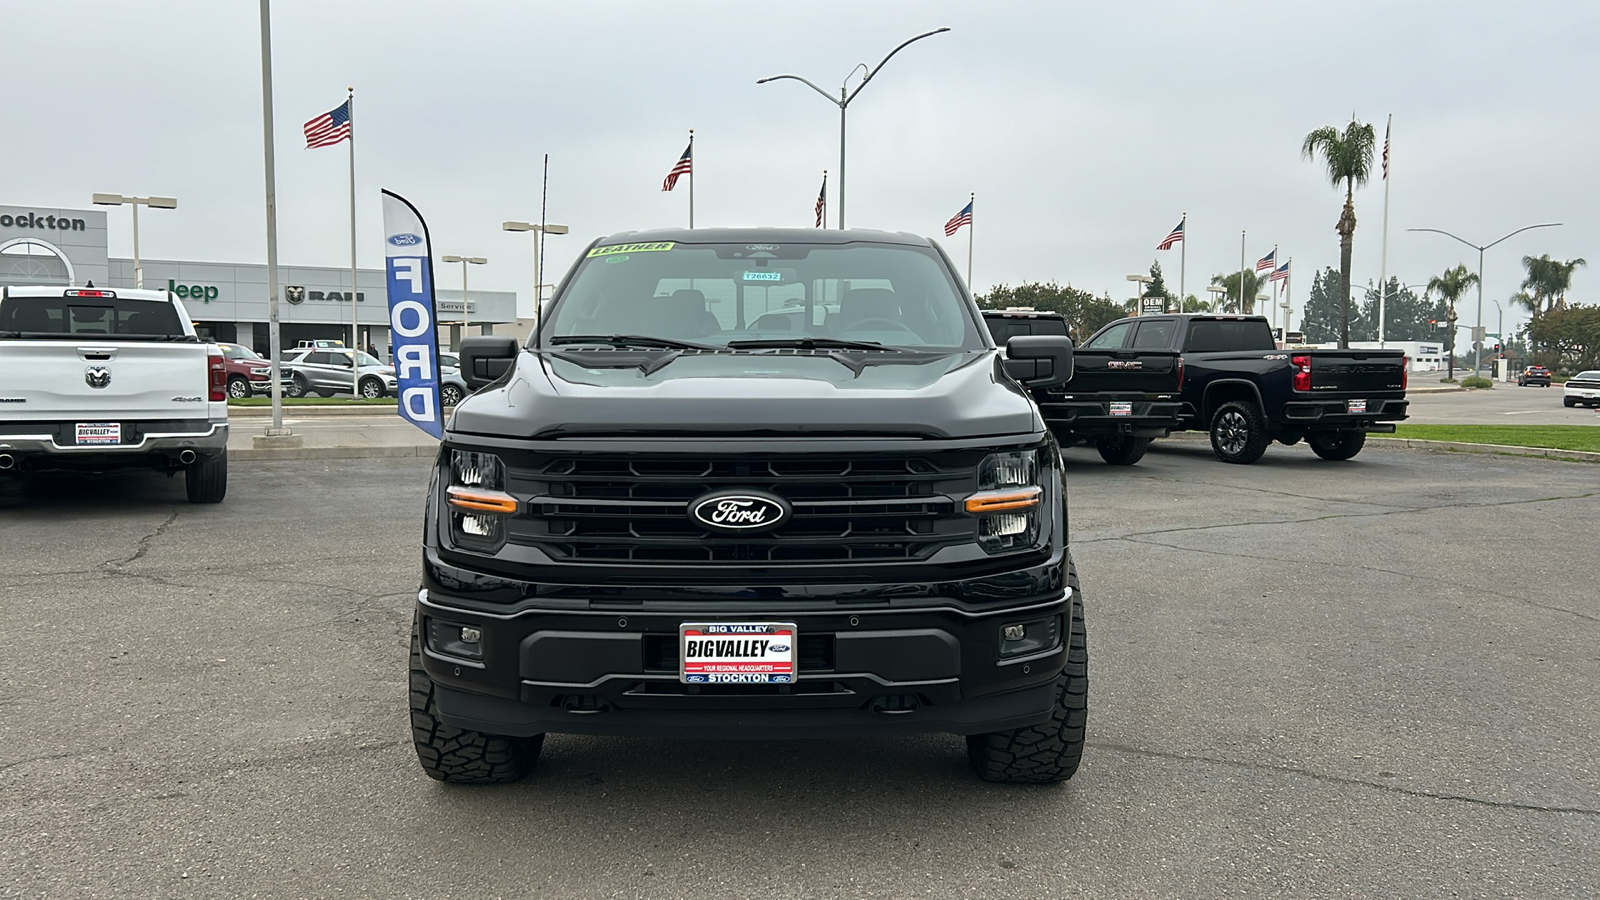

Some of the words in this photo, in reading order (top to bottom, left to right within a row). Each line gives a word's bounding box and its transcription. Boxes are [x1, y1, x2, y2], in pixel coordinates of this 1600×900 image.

[0, 212, 85, 231] ockton
[592, 243, 670, 255] LEATHER
[1143, 298, 1163, 306] OEM
[1108, 361, 1142, 369] GMC
[712, 500, 767, 522] Ford
[709, 625, 728, 633] BIG
[730, 625, 768, 633] VALLEY
[686, 640, 769, 657] BIGVALLEY
[708, 674, 769, 682] STOCKTON
